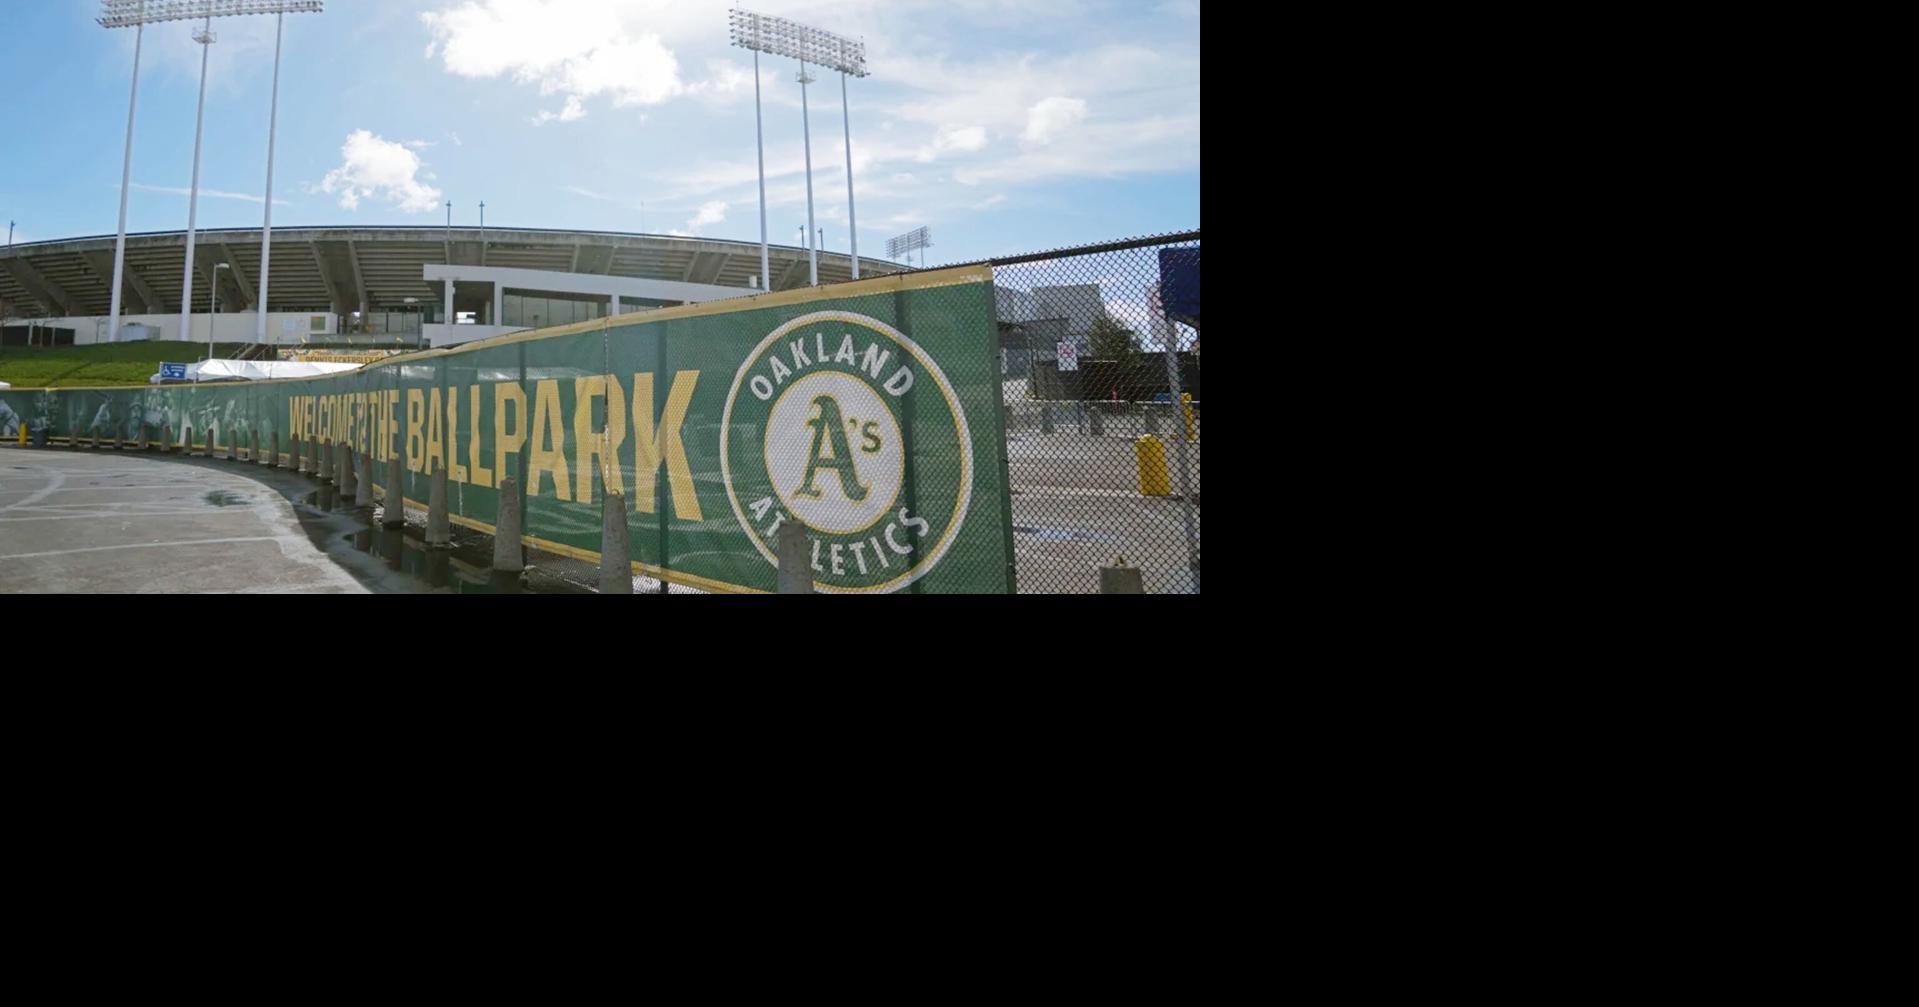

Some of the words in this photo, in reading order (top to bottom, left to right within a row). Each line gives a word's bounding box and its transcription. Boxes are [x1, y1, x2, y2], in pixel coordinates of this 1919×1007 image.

[749, 332, 914, 400] OAKLAND
[289, 393, 354, 450] WELCOME
[369, 389, 399, 463] THE
[406, 369, 704, 521] BALLPARK
[749, 496, 929, 576] ATLETICS
